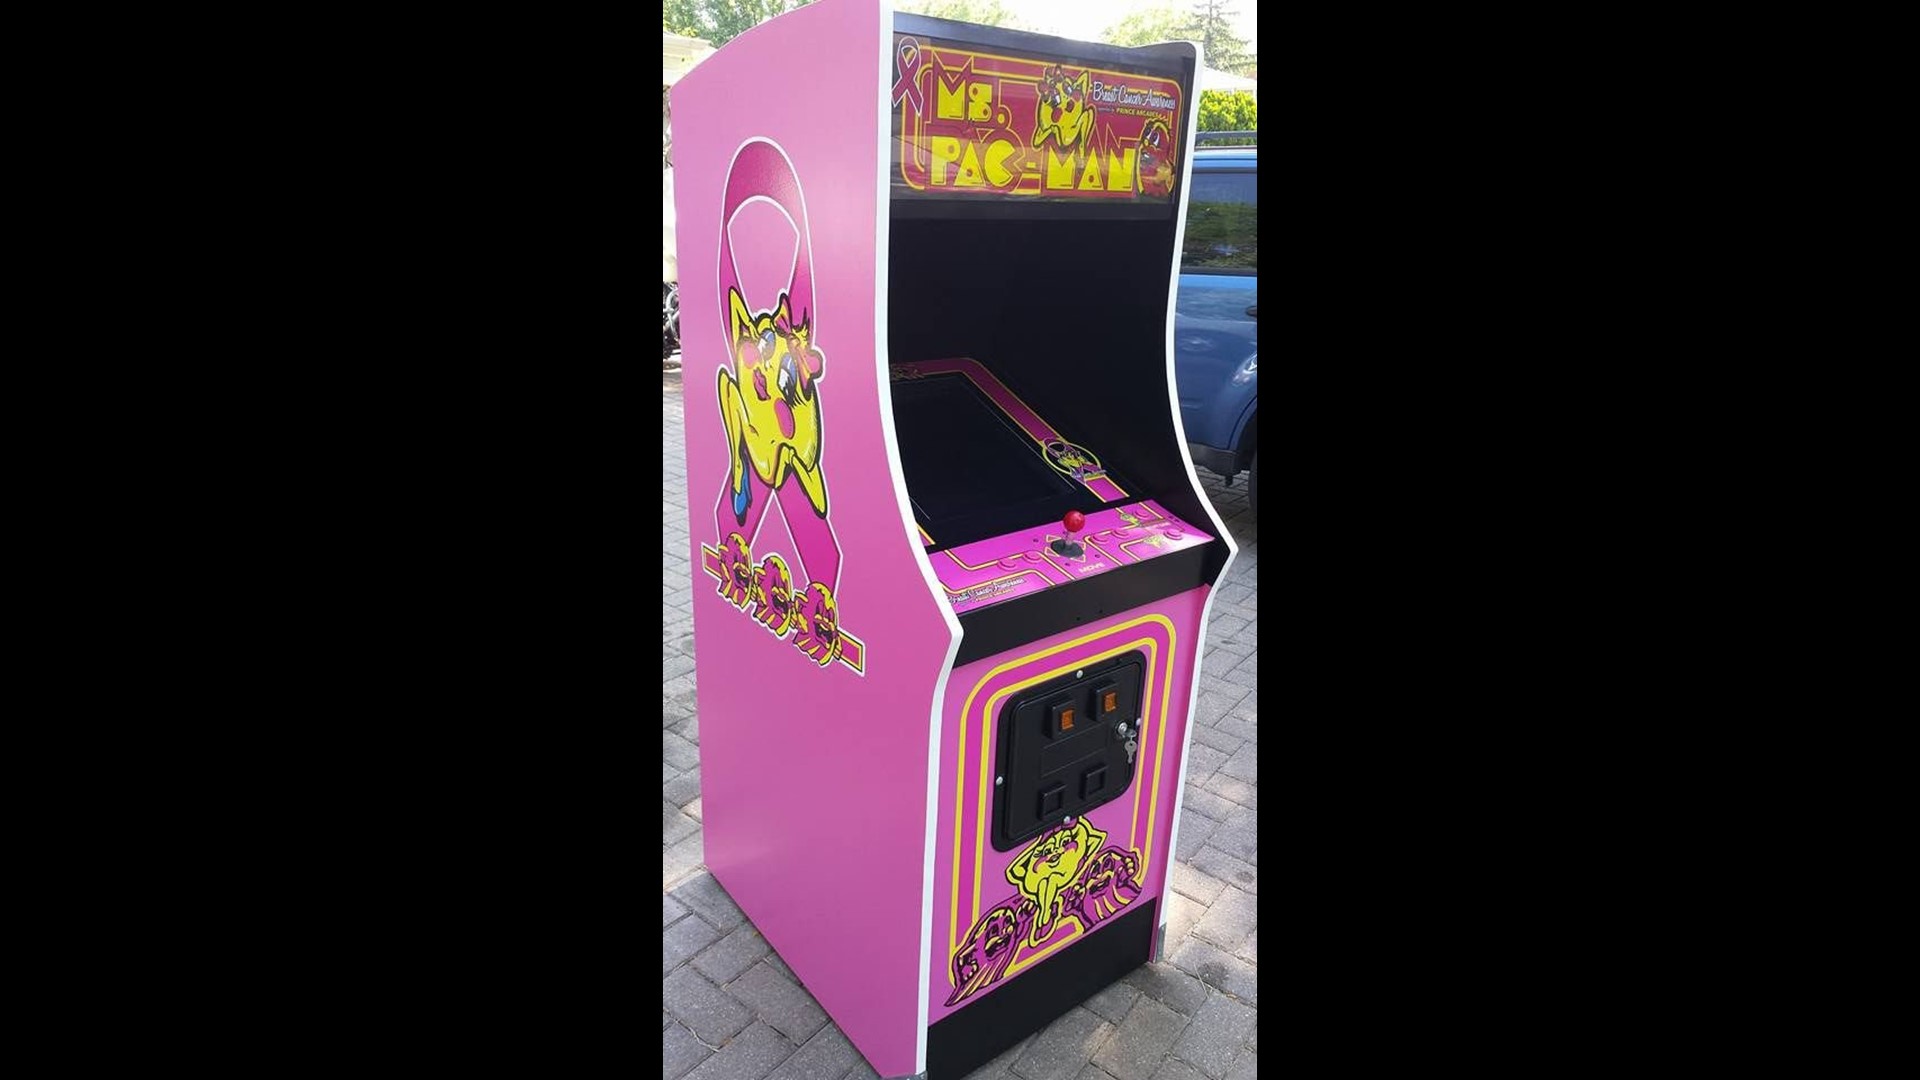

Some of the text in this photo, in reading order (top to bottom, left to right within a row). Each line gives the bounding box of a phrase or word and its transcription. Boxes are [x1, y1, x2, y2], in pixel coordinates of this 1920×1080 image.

[936, 75, 1005, 124] MS.
[1093, 81, 1119, 102] Breast
[1118, 85, 1143, 104] Cancer
[1116, 106, 1136, 115] PRINCE
[1079, 562, 1105, 574] MOVE
